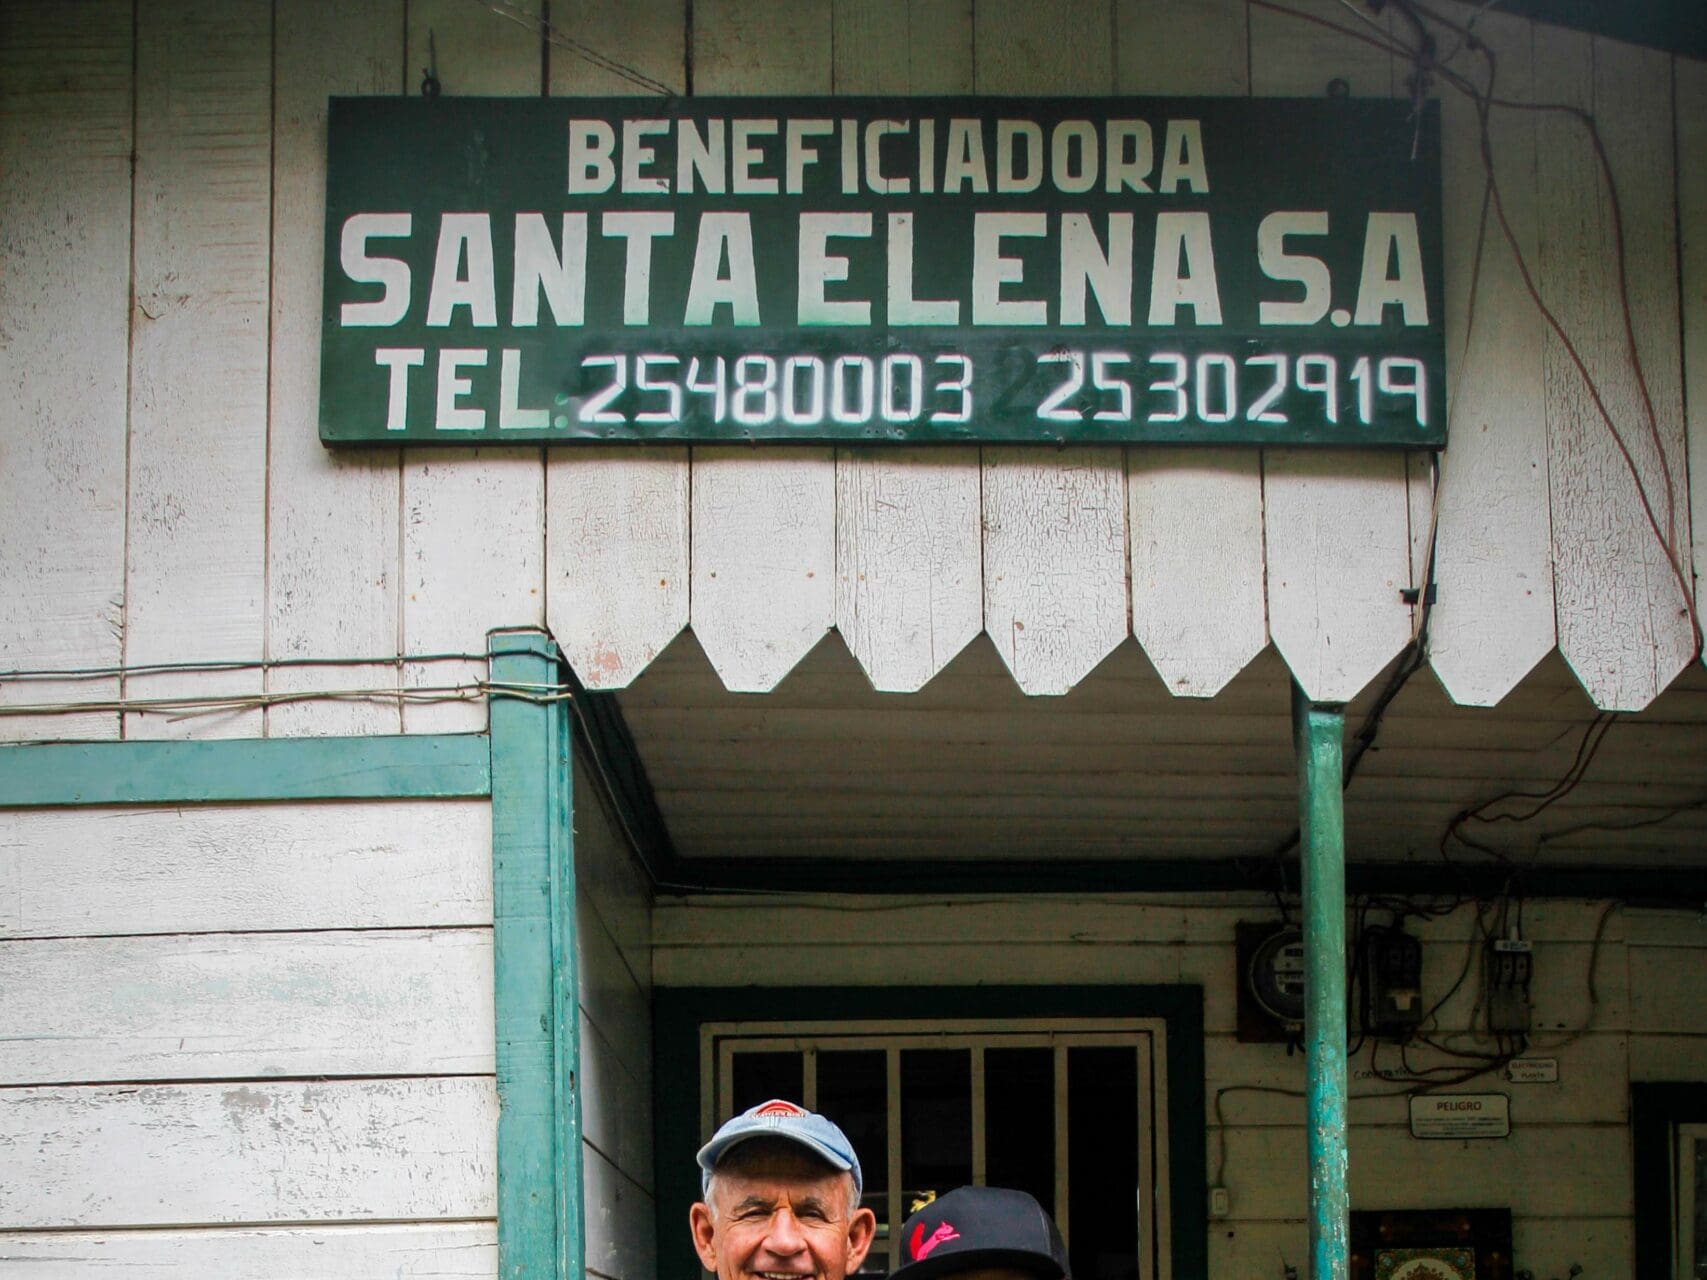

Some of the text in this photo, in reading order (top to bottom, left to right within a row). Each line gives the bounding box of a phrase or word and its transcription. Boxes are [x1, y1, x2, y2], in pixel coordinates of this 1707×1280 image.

[567, 118, 1210, 195] BENEFICIADORA
[340, 210, 1430, 328] SANTA ELENA S.A
[578, 353, 974, 426] 25480003
[1036, 350, 1428, 427] 25302919
[1436, 1100, 1483, 1112] PELIGRO
